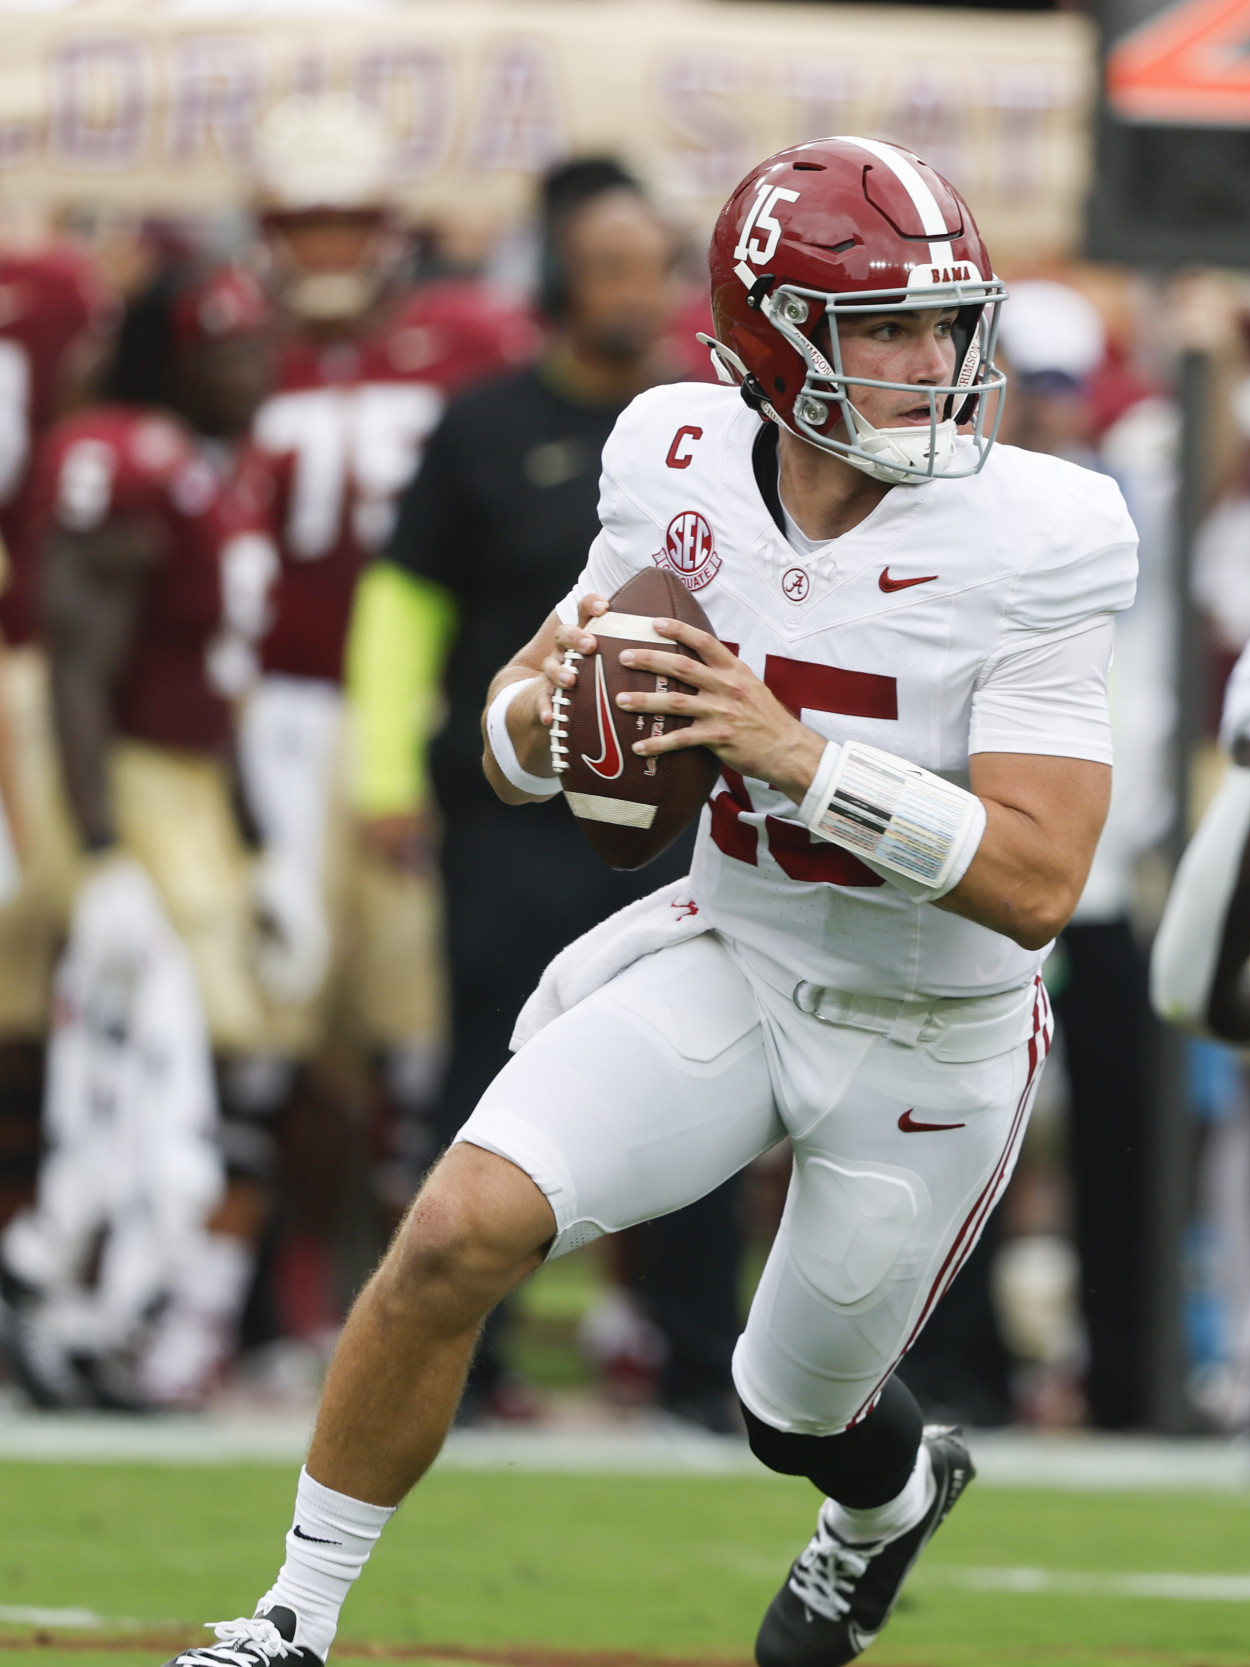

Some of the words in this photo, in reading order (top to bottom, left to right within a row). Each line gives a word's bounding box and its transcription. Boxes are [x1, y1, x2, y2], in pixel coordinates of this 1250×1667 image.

[733, 184, 800, 265] 15
[931, 266, 971, 283] BAMA
[795, 331, 833, 376] IMSON
[958, 343, 981, 388] RIMSON
[666, 425, 703, 469] C
[668, 514, 711, 569] SEC
